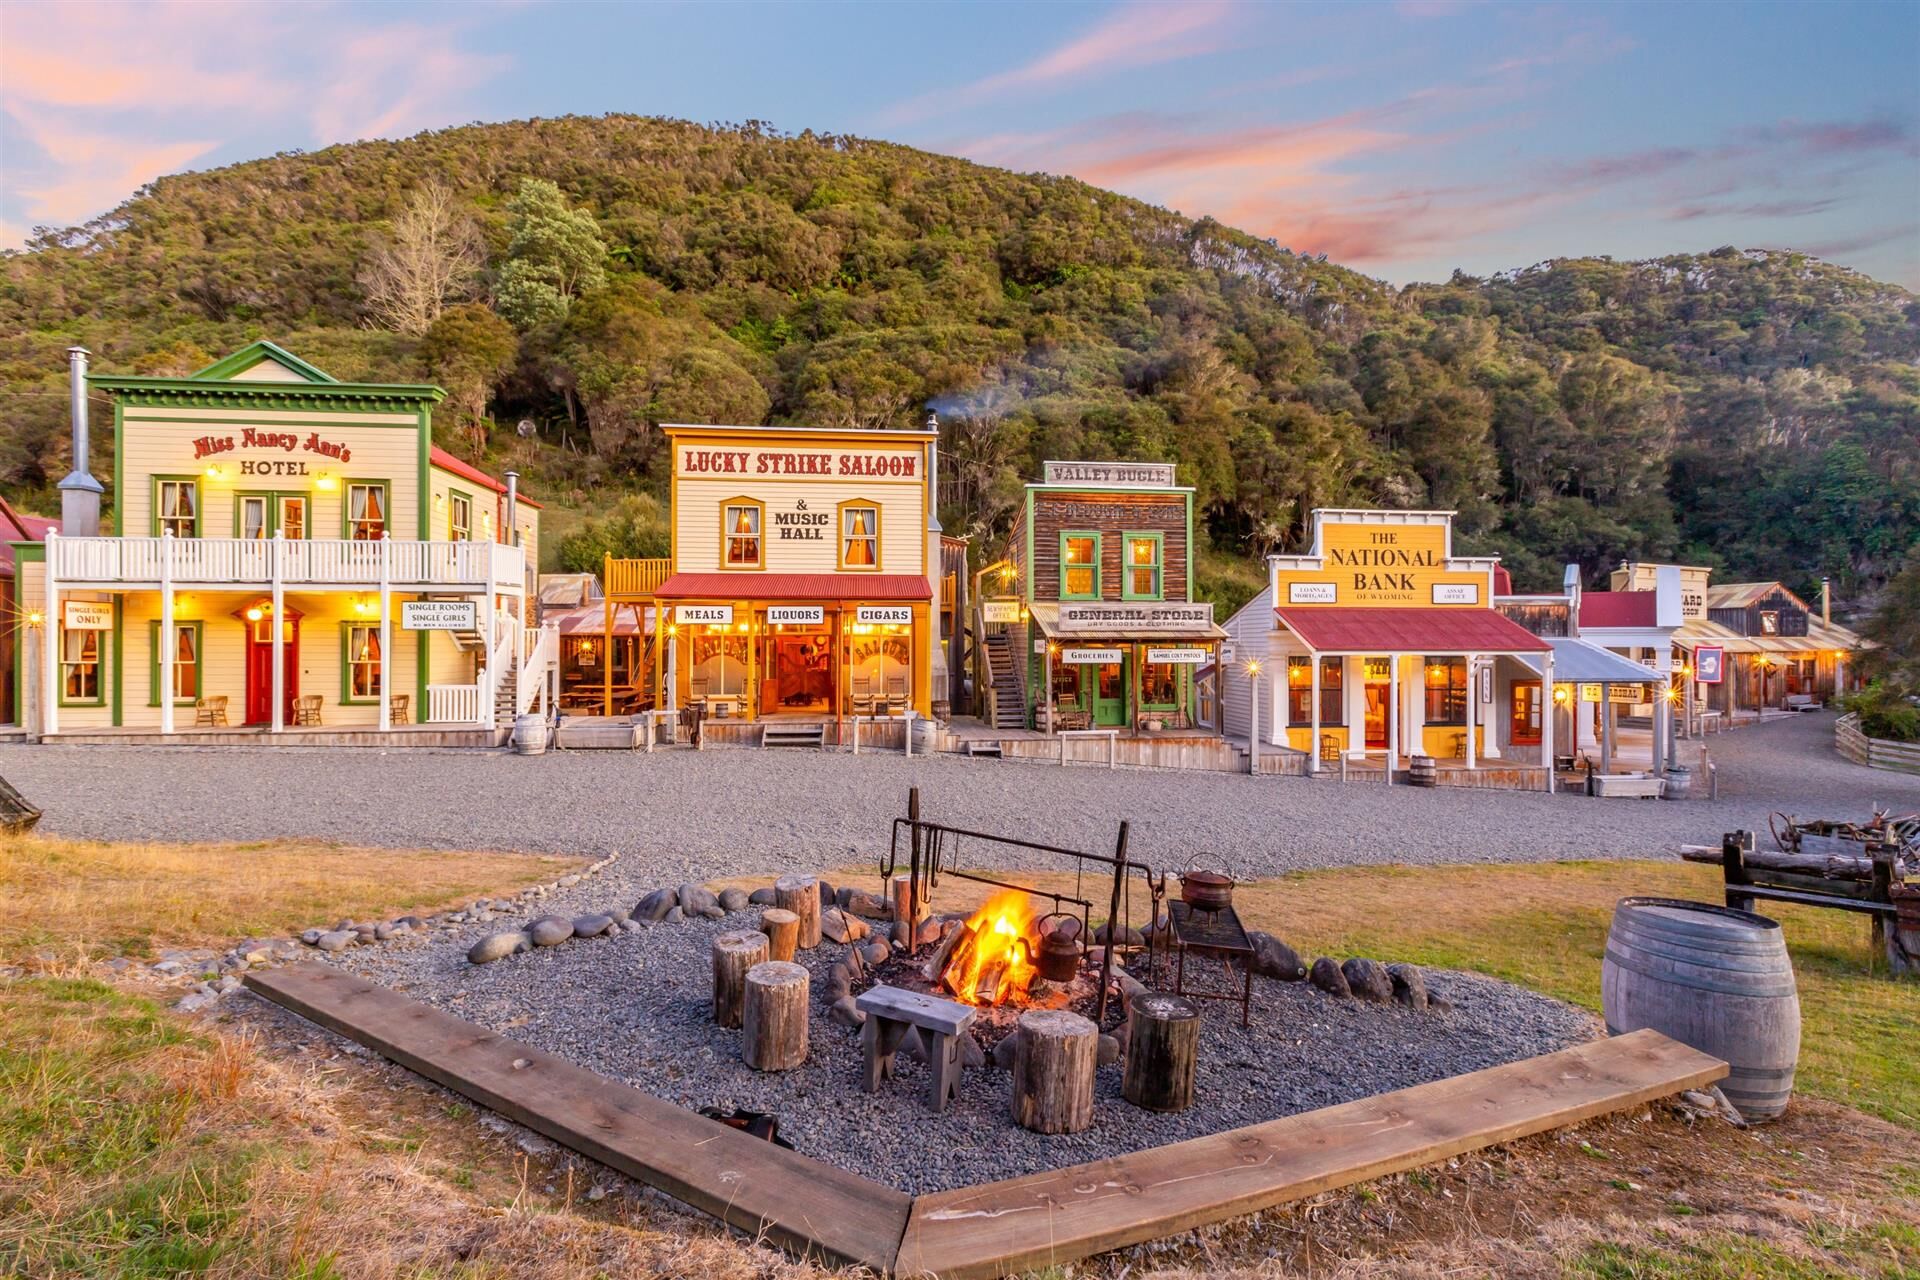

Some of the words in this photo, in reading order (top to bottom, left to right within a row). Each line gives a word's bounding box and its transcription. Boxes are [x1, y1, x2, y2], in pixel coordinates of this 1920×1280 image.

[192, 436, 235, 460] Miss
[241, 428, 298, 451] Nancy
[303, 432, 351, 463] Ann's
[240, 460, 310, 476] HOTEL
[685, 451, 751, 473] LUCKY
[756, 453, 832, 475] STRIKE
[839, 455, 916, 477] SALOON
[1053, 468, 1111, 481] VALLEY
[1117, 469, 1165, 482] BUGLE
[796, 499, 808, 511] &
[775, 513, 829, 526] MUSIC
[780, 528, 823, 540] HALL
[1369, 532, 1398, 545] THE
[1331, 548, 1439, 567] NATIONAL
[1354, 573, 1416, 591] BANK
[76, 615, 101, 624] ONLY
[685, 610, 724, 619] MEALS
[771, 610, 819, 620] LIQUORS
[861, 610, 908, 620] CIGARS
[1068, 610, 1146, 621] GENERAL
[1151, 610, 1204, 621] STORE
[1609, 688, 1637, 698] ARSHAL
